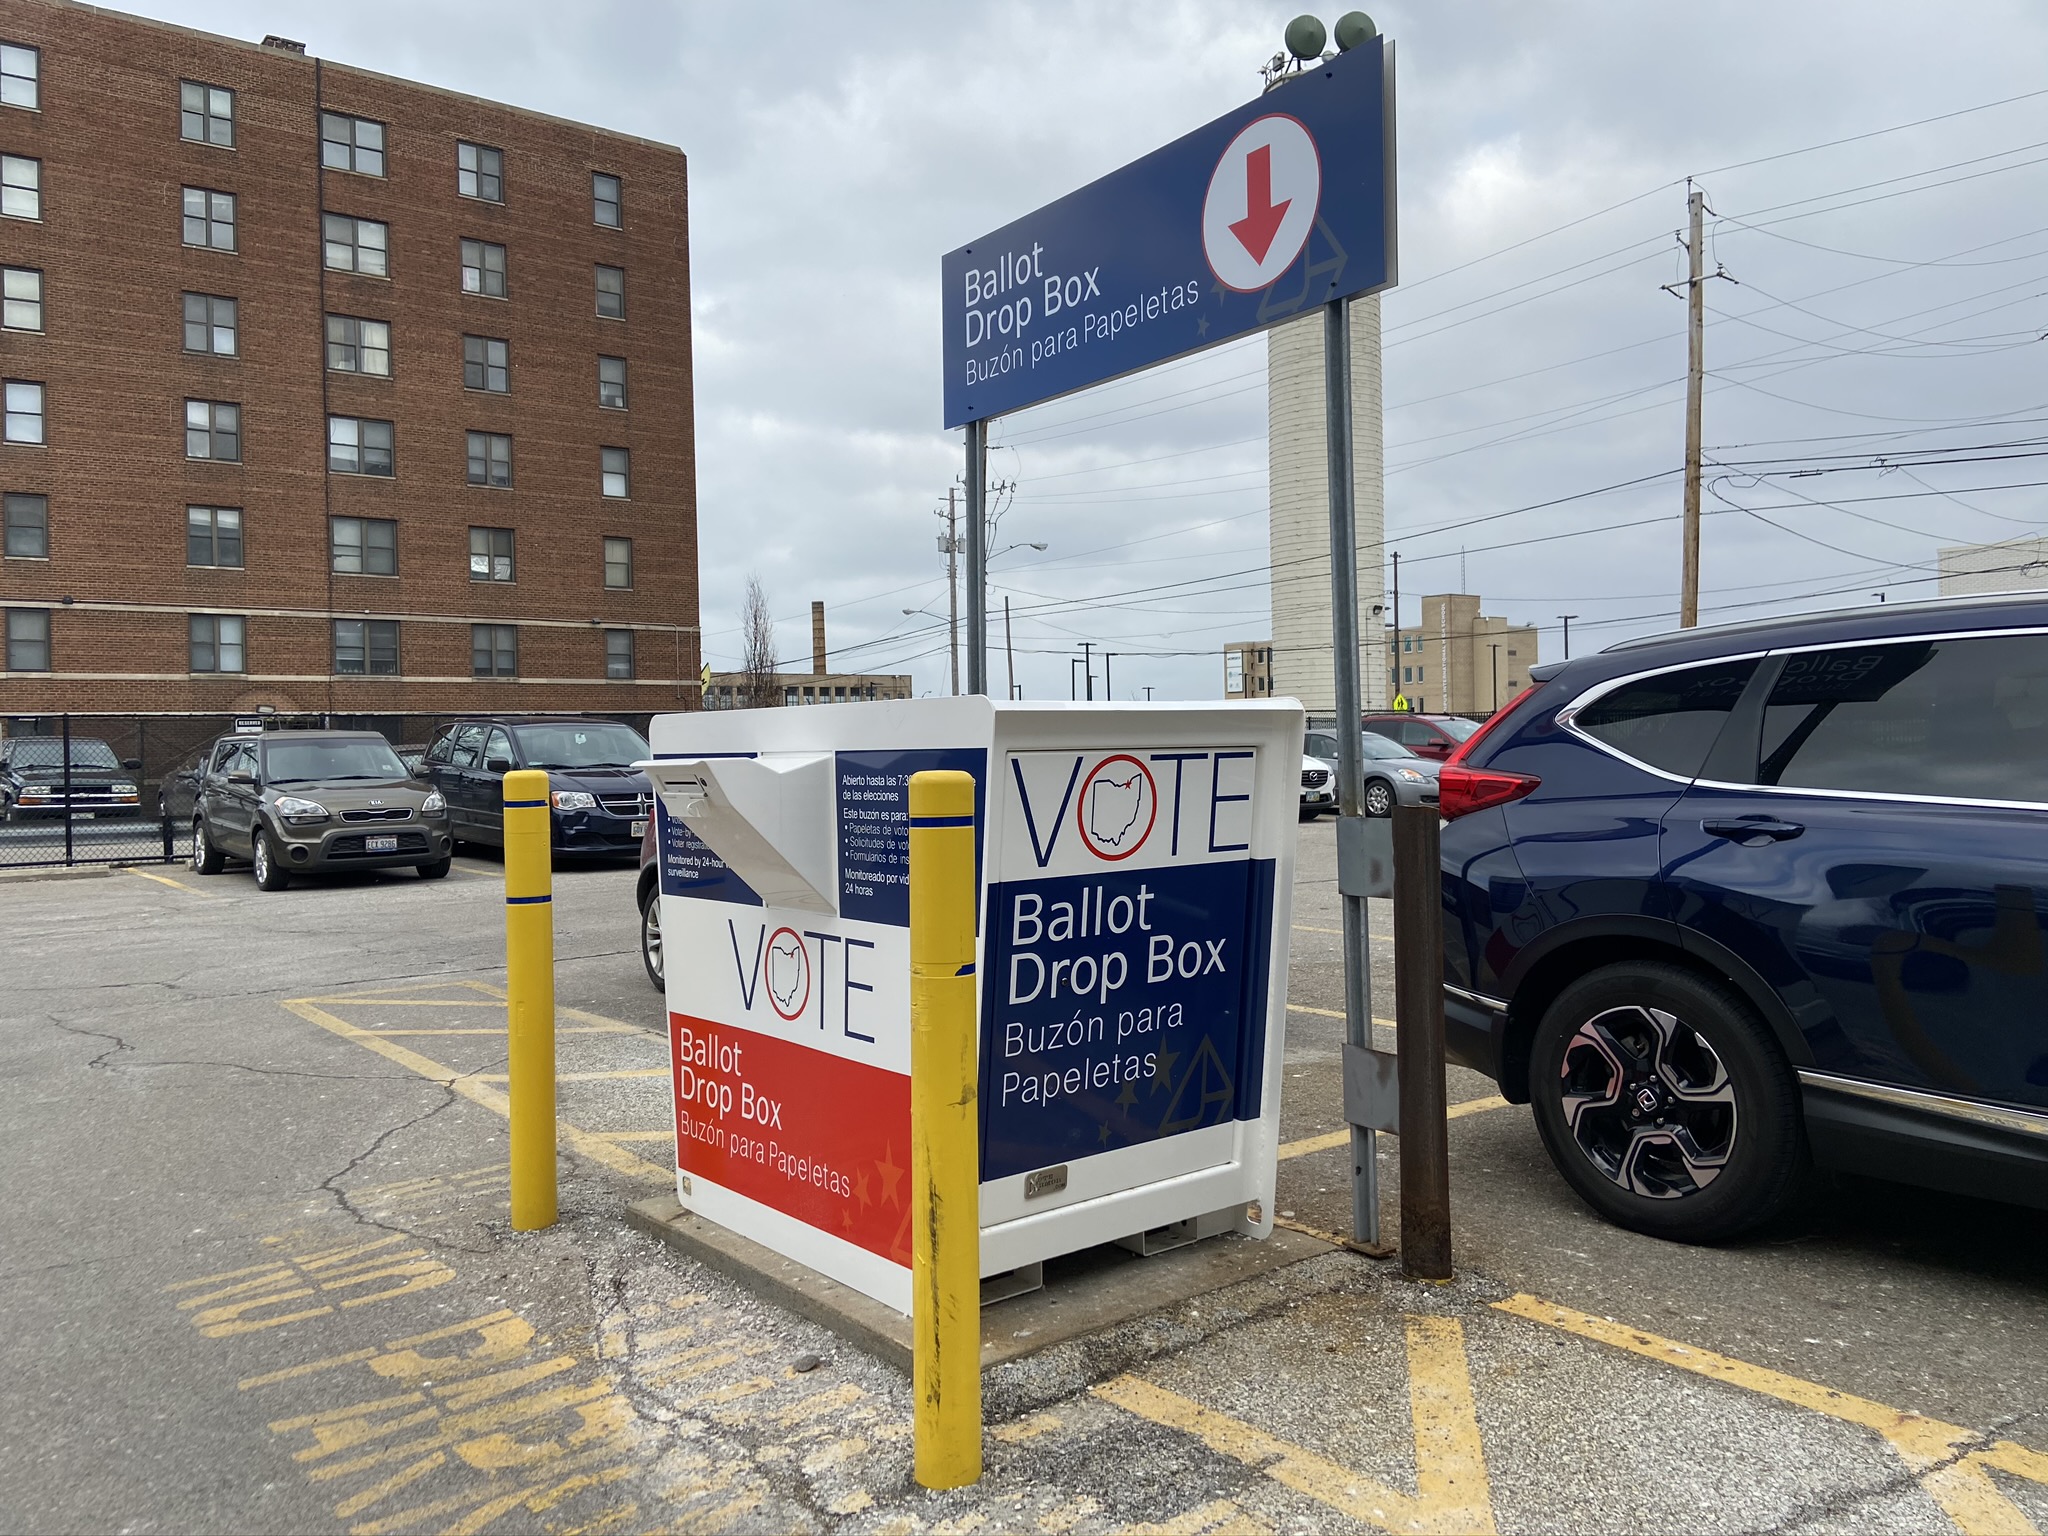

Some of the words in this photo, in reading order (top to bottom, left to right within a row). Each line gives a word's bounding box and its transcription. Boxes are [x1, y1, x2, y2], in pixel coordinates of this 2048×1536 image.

[965, 242, 1043, 308] Ballot
[965, 296, 1032, 348] Drop
[1044, 266, 1101, 317] Box
[966, 344, 1023, 386] Buzón
[1031, 327, 1078, 369] para
[1084, 280, 1199, 343] Papeletas
[842, 774, 865, 787] Abierto
[866, 775, 885, 787] hasta
[886, 775, 897, 787] las
[842, 789, 852, 800] de
[852, 789, 862, 800] las
[863, 790, 899, 801] elecciones
[843, 808, 858, 819] Este
[859, 808, 880, 820] buzón
[880, 812, 889, 821] es
[890, 812, 909, 823] para:
[849, 823, 881, 836] Papeletas
[882, 824, 892, 835] de
[1011, 752, 1254, 868] VOTE
[667, 853, 693, 866] Monitored
[694, 857, 702, 869] by
[702, 856, 724, 868] 24-hour
[671, 838, 686, 848] Voter
[849, 836, 885, 849] Solicitudes
[886, 838, 896, 850] de
[898, 839, 910, 851] vot
[849, 850, 886, 863] Formularios
[888, 853, 898, 865] de
[900, 854, 910, 865] ins
[667, 867, 699, 879] surveillance
[844, 868, 885, 883] Monitoreado
[886, 873, 898, 885] por
[899, 873, 910, 885] vid
[845, 882, 854, 894] 24
[854, 883, 873, 896] horas
[1012, 884, 1154, 946] Ballot
[728, 918, 875, 1044] VOTE
[1009, 951, 1128, 1006] Drop
[1147, 934, 1227, 983] Box
[680, 1027, 742, 1077] Ballot
[1005, 1009, 1104, 1057] Buzón
[1117, 1002, 1183, 1044] para
[680, 1065, 733, 1120] Drop
[741, 1082, 783, 1130] Box
[1002, 1052, 1157, 1107] Papeletas
[681, 1109, 725, 1149] Buzón
[730, 1132, 765, 1165] para
[769, 1141, 850, 1198] Papeletas
[160, 1230, 457, 1339] NO
